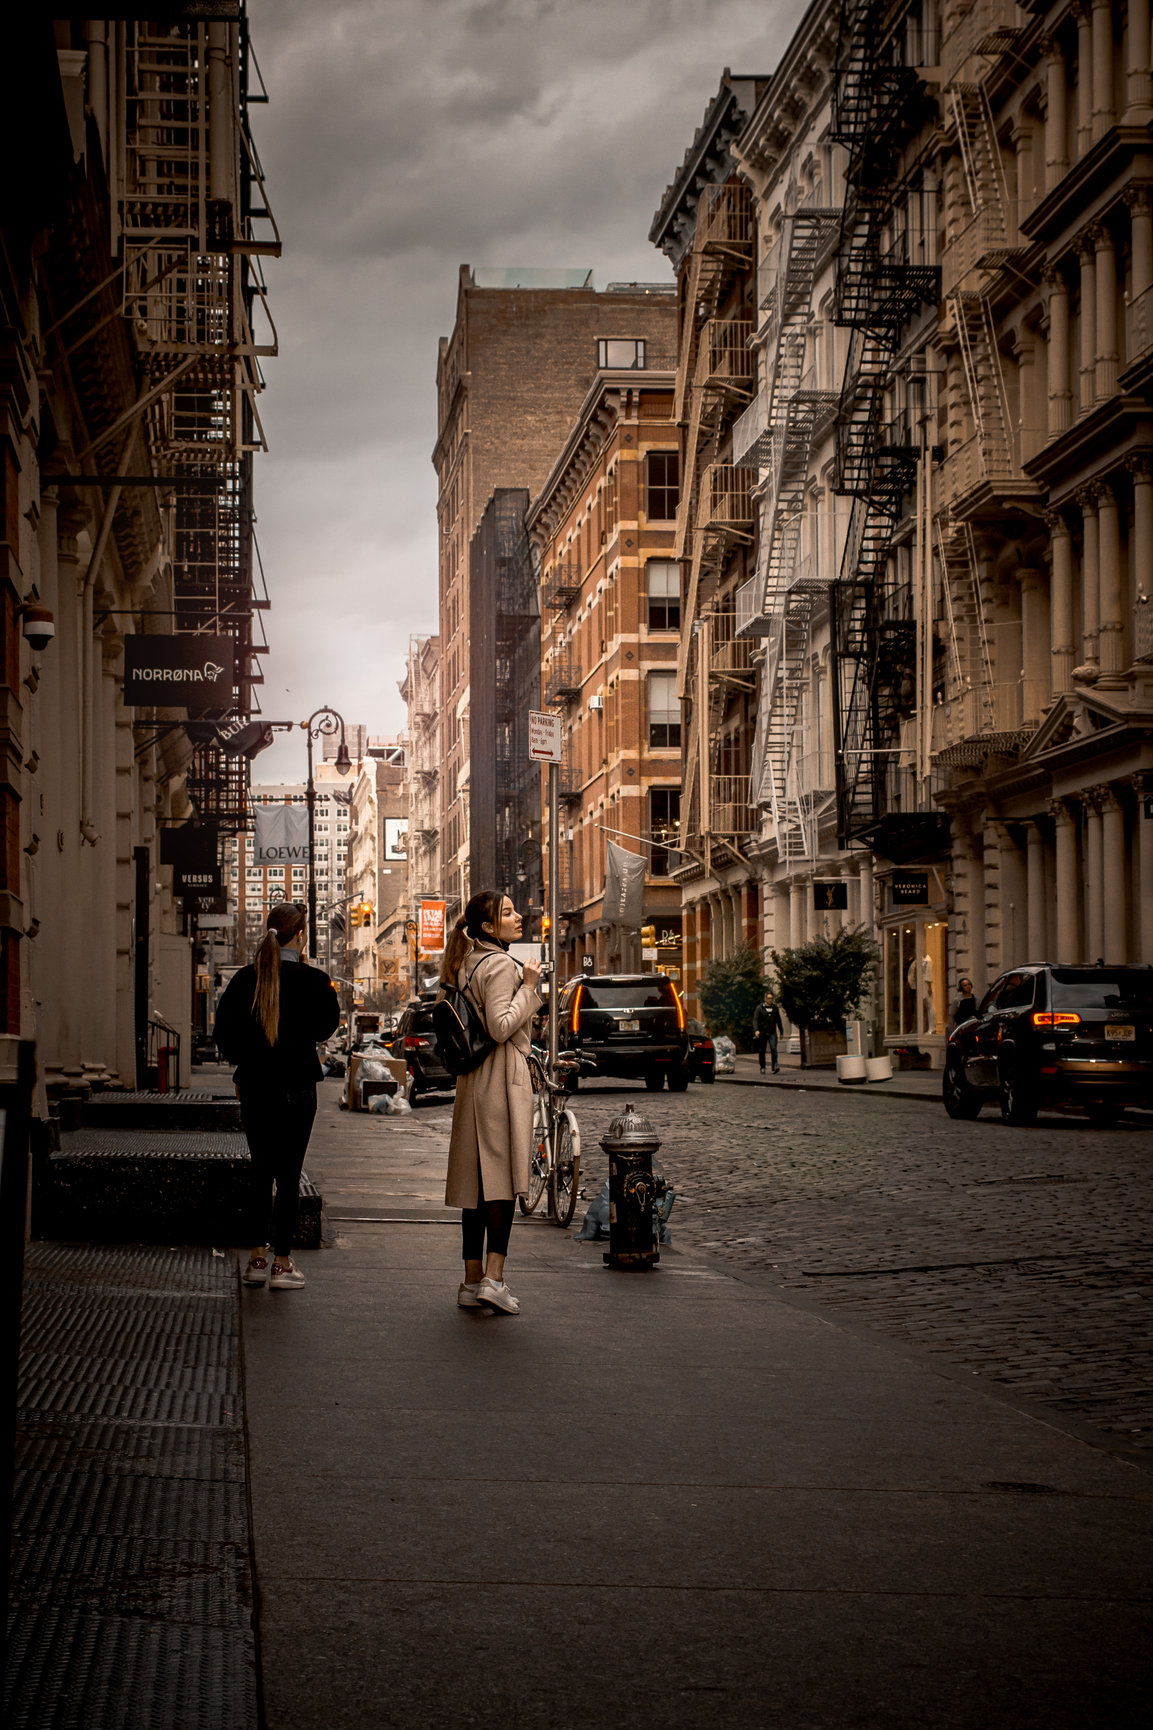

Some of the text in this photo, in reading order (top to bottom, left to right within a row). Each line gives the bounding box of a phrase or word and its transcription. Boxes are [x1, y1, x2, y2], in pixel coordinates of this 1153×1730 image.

[132, 668, 204, 681] NORRØNA
[537, 716, 555, 728] PARKING
[259, 846, 310, 859] LOEWE
[181, 874, 213, 883] VERSUS
